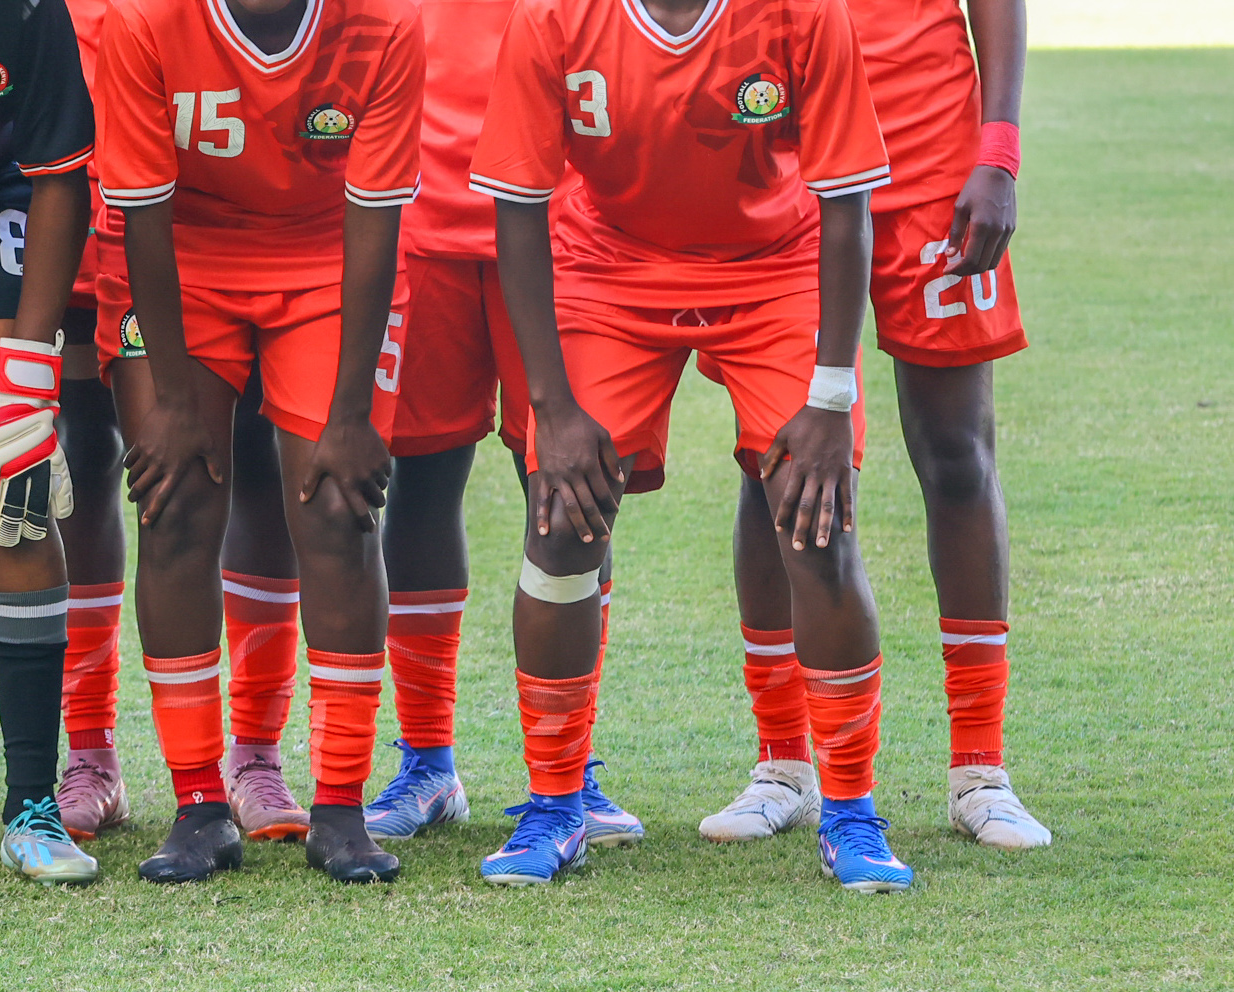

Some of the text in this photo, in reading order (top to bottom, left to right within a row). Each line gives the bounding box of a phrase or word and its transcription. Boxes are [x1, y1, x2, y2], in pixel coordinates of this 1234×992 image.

[565, 70, 612, 138] 3
[737, 81, 750, 113] FOOTBALL
[172, 86, 246, 158] 15
[742, 112, 783, 124] FEDERATION
[120, 314, 130, 347] FOOTBALL
[125, 349, 147, 358] FEDERA
